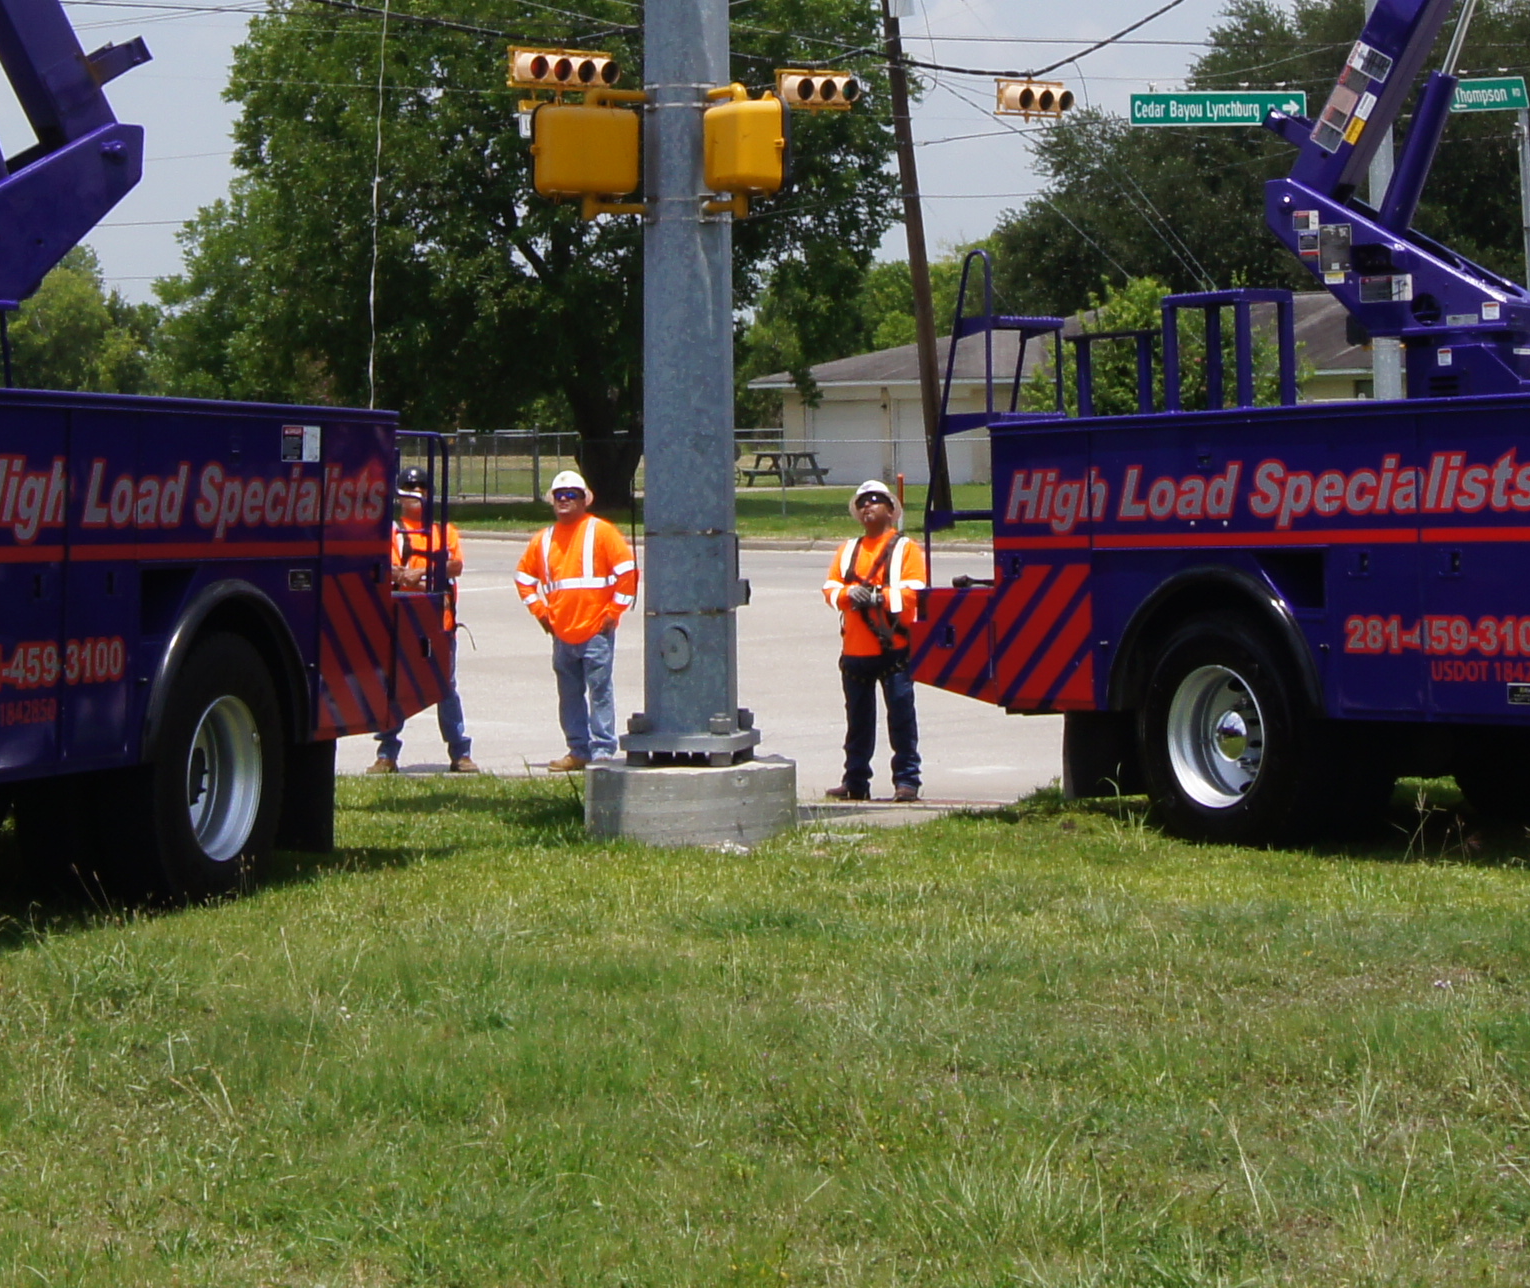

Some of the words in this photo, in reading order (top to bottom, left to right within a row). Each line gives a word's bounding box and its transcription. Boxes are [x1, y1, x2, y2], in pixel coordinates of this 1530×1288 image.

[1134, 100, 1166, 118] Cedar
[1170, 100, 1203, 122] Bayou
[1207, 100, 1260, 122] Lynchburg
[81, 457, 191, 529] Load
[195, 460, 386, 542] Specialists
[1005, 466, 1109, 535] High
[1116, 461, 1242, 522] Load
[1431, 661, 1489, 682] USDOT
